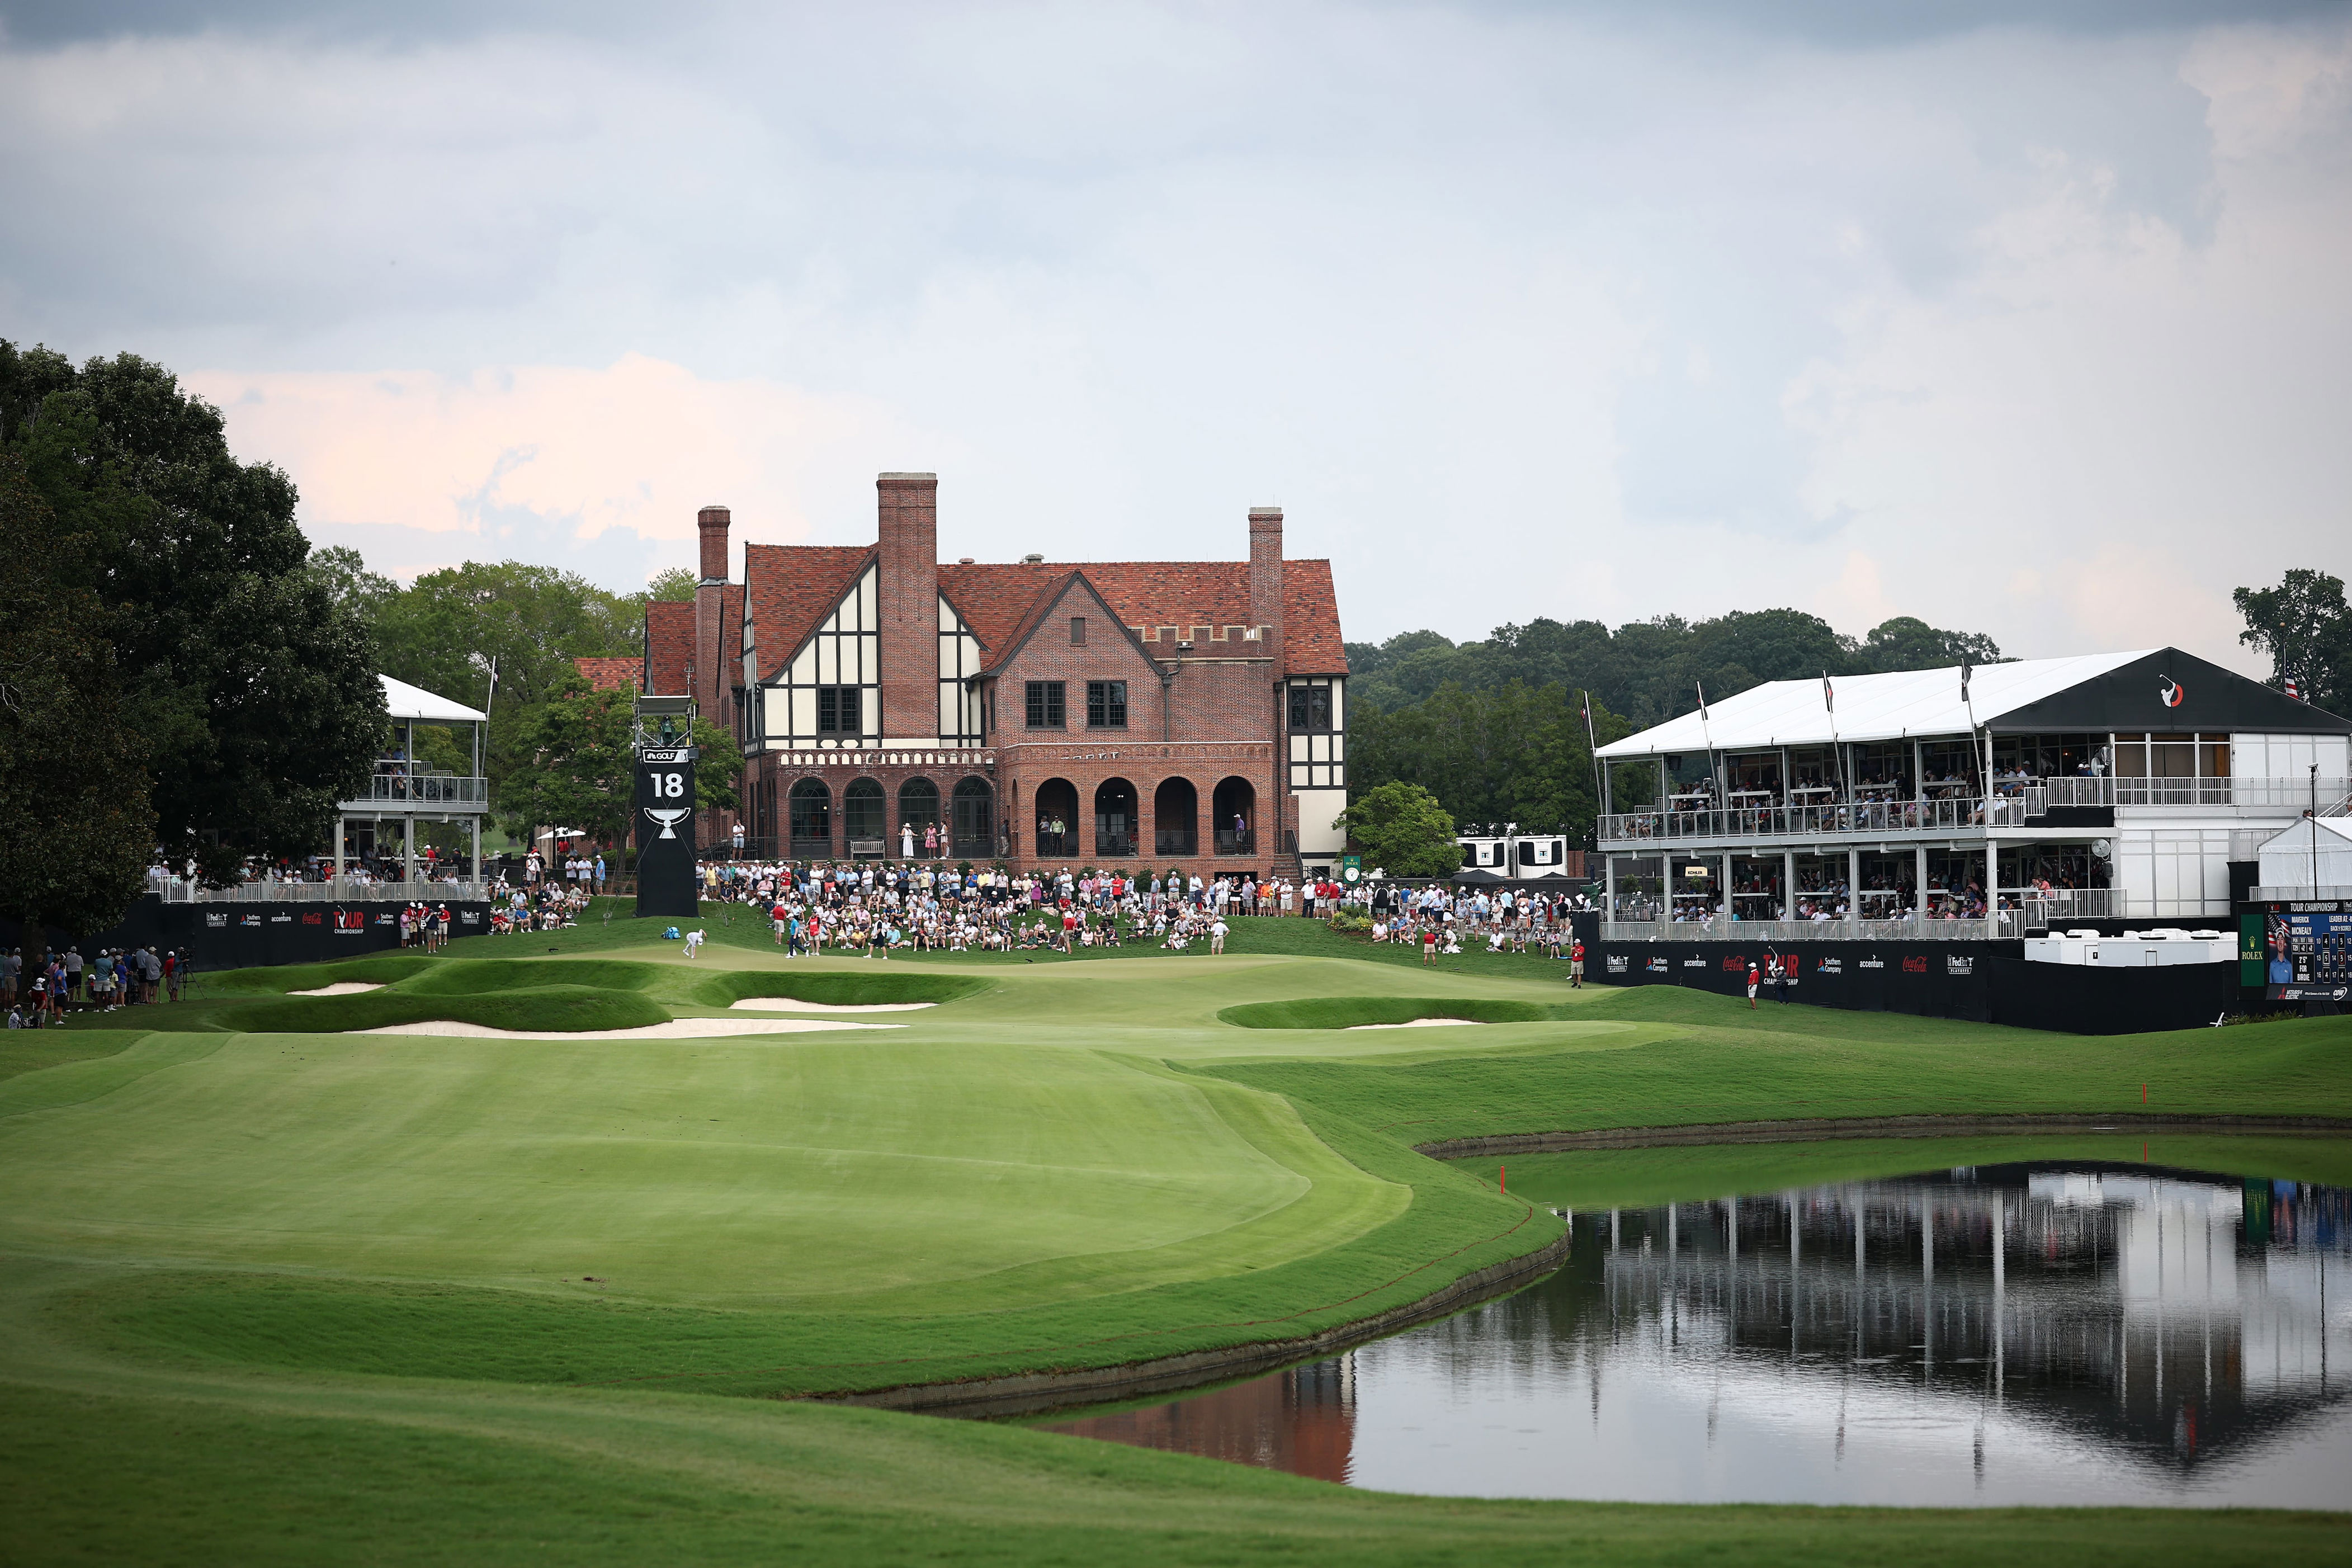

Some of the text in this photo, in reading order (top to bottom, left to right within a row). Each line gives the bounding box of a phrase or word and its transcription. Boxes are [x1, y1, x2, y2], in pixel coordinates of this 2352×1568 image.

[651, 773, 683, 797] 18
[2290, 903, 2303, 911] TOUR
[2304, 903, 2337, 912] CHAMPIONSHIP
[2292, 927, 2312, 935] MCNEALY
[2242, 951, 2263, 960] ROLEX
[1610, 956, 1624, 965] FedEx
[1859, 960, 1884, 968] accenture
[1952, 957, 1967, 966] FedEx
[1652, 964, 1668, 972] Company
[1825, 965, 1841, 974] Company
